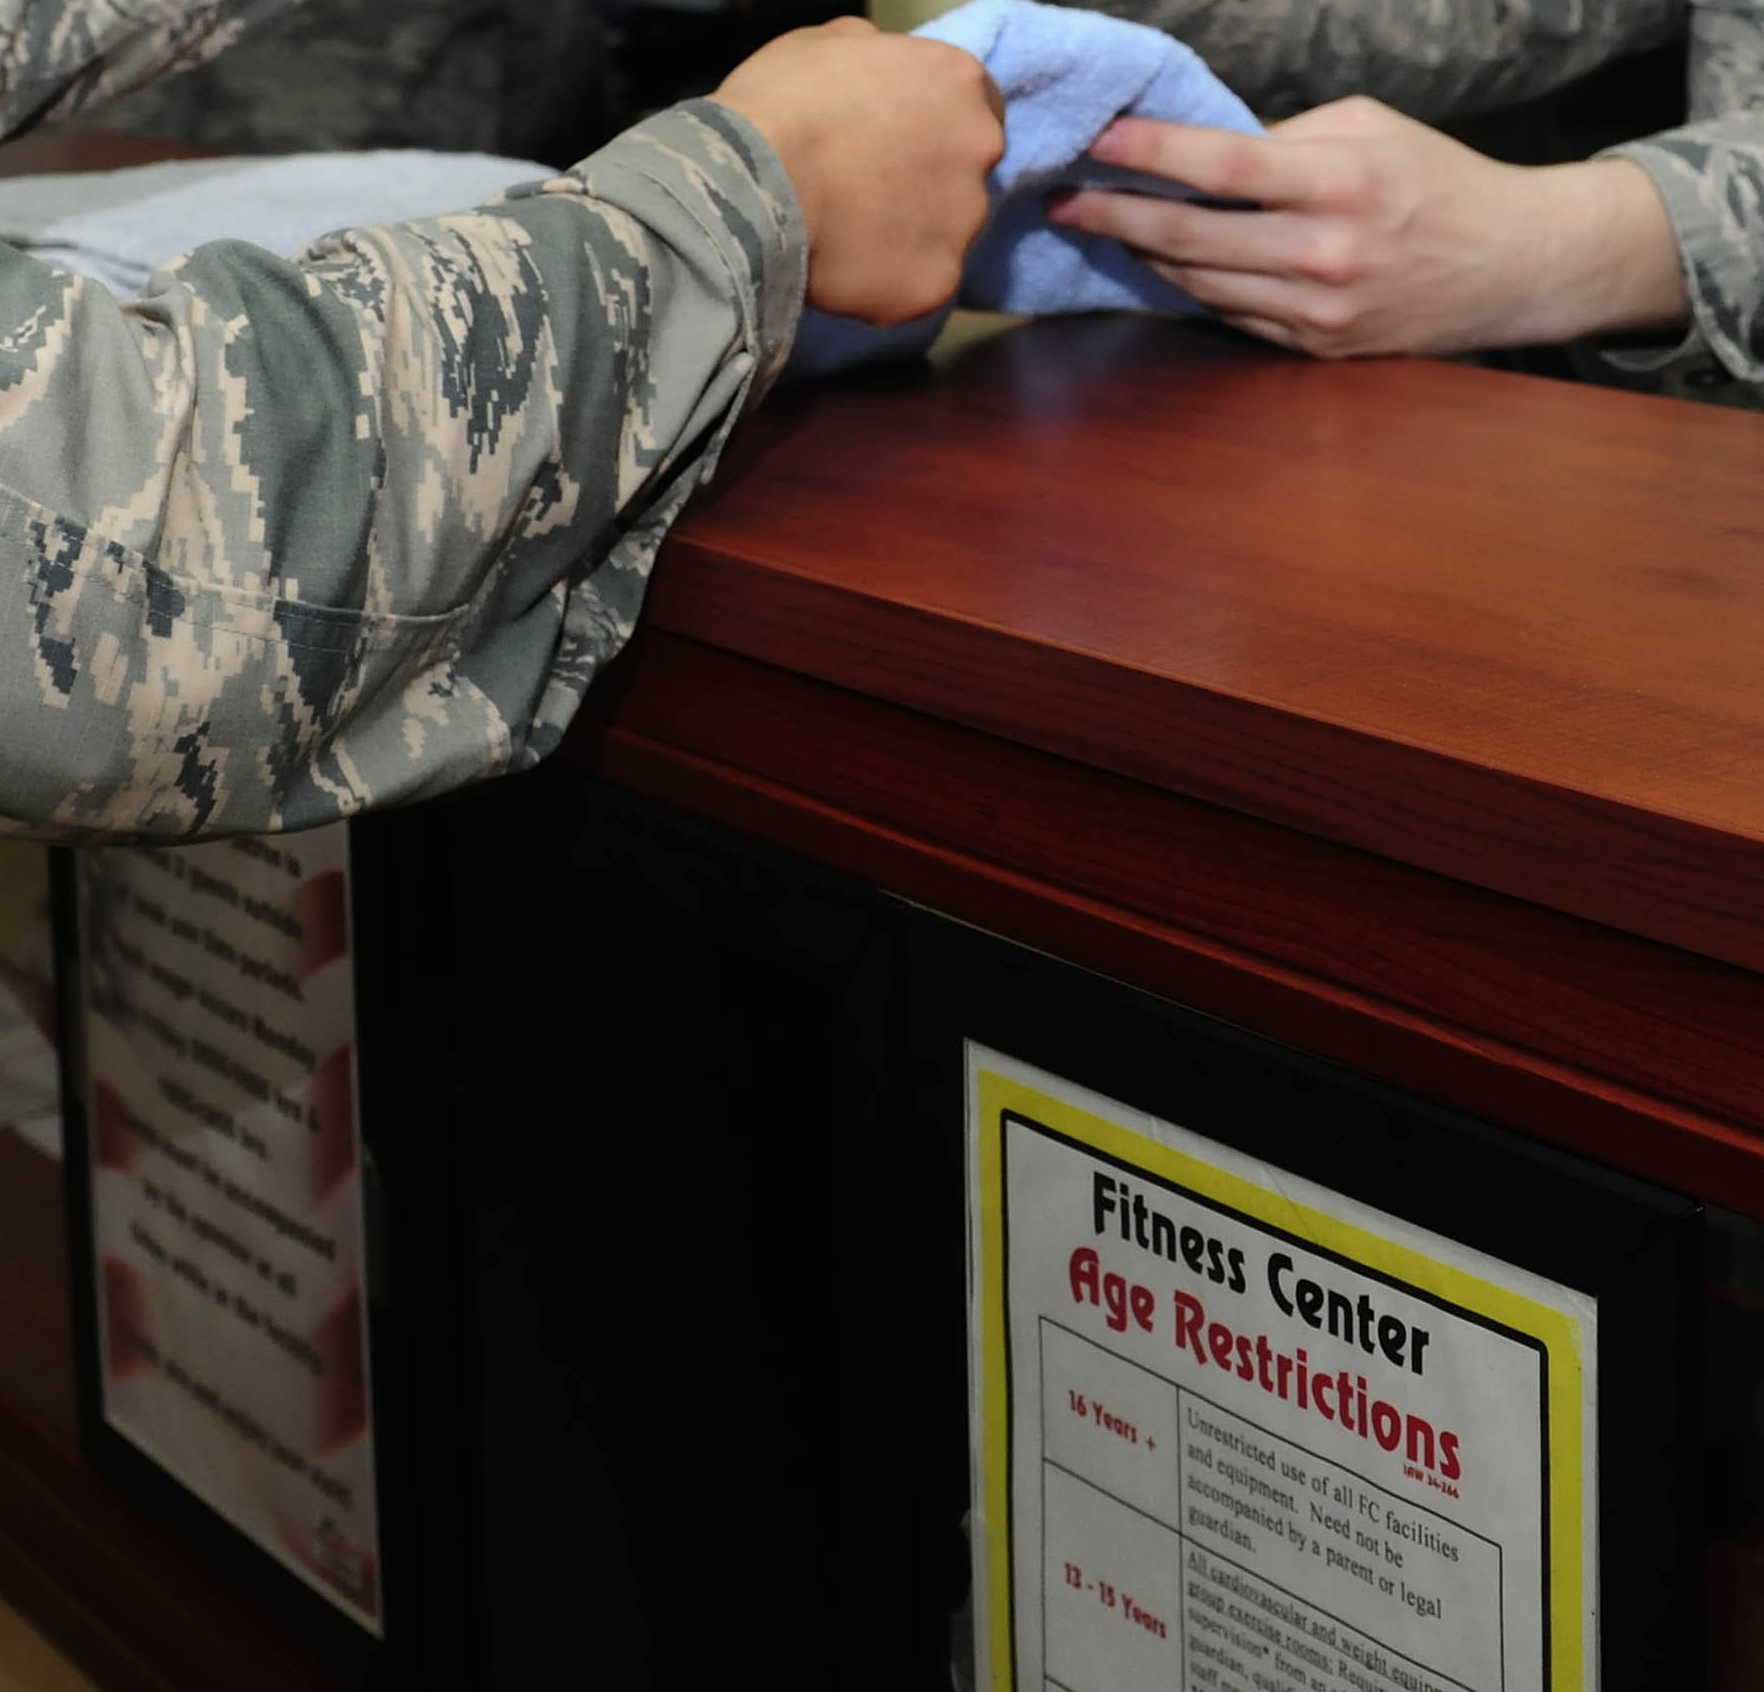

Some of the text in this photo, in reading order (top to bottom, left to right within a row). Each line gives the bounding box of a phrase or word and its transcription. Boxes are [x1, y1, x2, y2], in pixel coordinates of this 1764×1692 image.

[1092, 1170, 1430, 1375] Fitness Center
[1069, 1247, 1462, 1481] Age Restrictions
[1069, 1389, 1086, 1417] 16
[1093, 1401, 1137, 1443] Years
[1188, 1407, 1459, 1562] Unrestricted use of all FC facilities
[1188, 1442, 1403, 1568] and equipment. Need not be
[1188, 1507, 1256, 1553] guardian.
[1188, 1476, 1441, 1619] accompanied by a parent or legal
[1099, 1582, 1116, 1608] 15
[1123, 1593, 1167, 1639] Years
